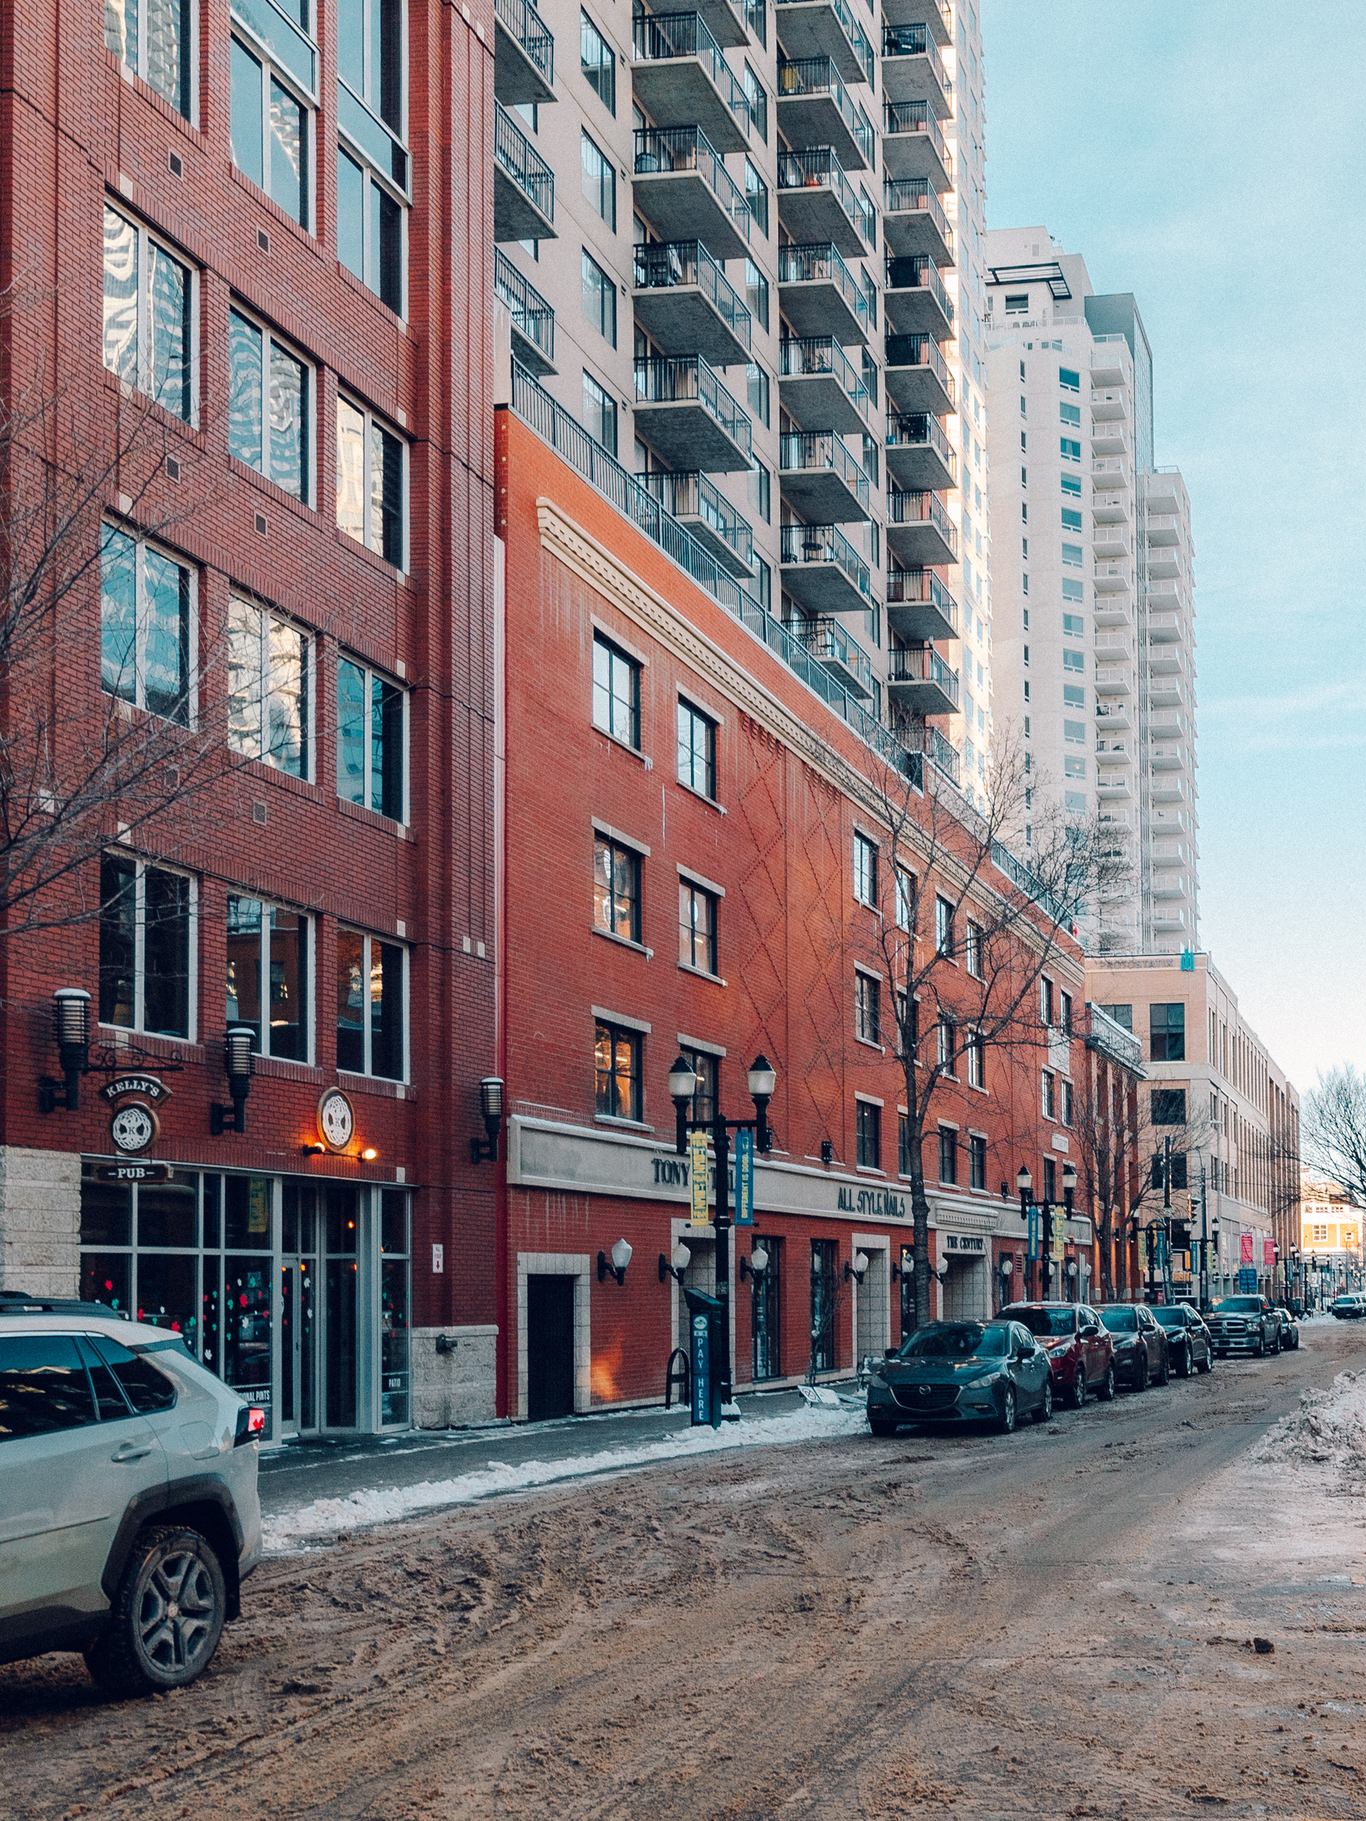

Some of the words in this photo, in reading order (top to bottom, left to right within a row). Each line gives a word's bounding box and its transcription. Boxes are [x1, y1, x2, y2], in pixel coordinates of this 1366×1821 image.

[106, 1079, 160, 1098] KELLY'S
[117, 1167, 146, 1179] PUB
[838, 1186, 856, 1212] ALL
[857, 1189, 884, 1216] STYLE
[883, 1190, 905, 1218] NAILS
[946, 1235, 958, 1249] THE
[960, 1236, 984, 1250] CENTURY
[697, 1338, 705, 1369] PAY
[697, 1378, 705, 1420] HERE
